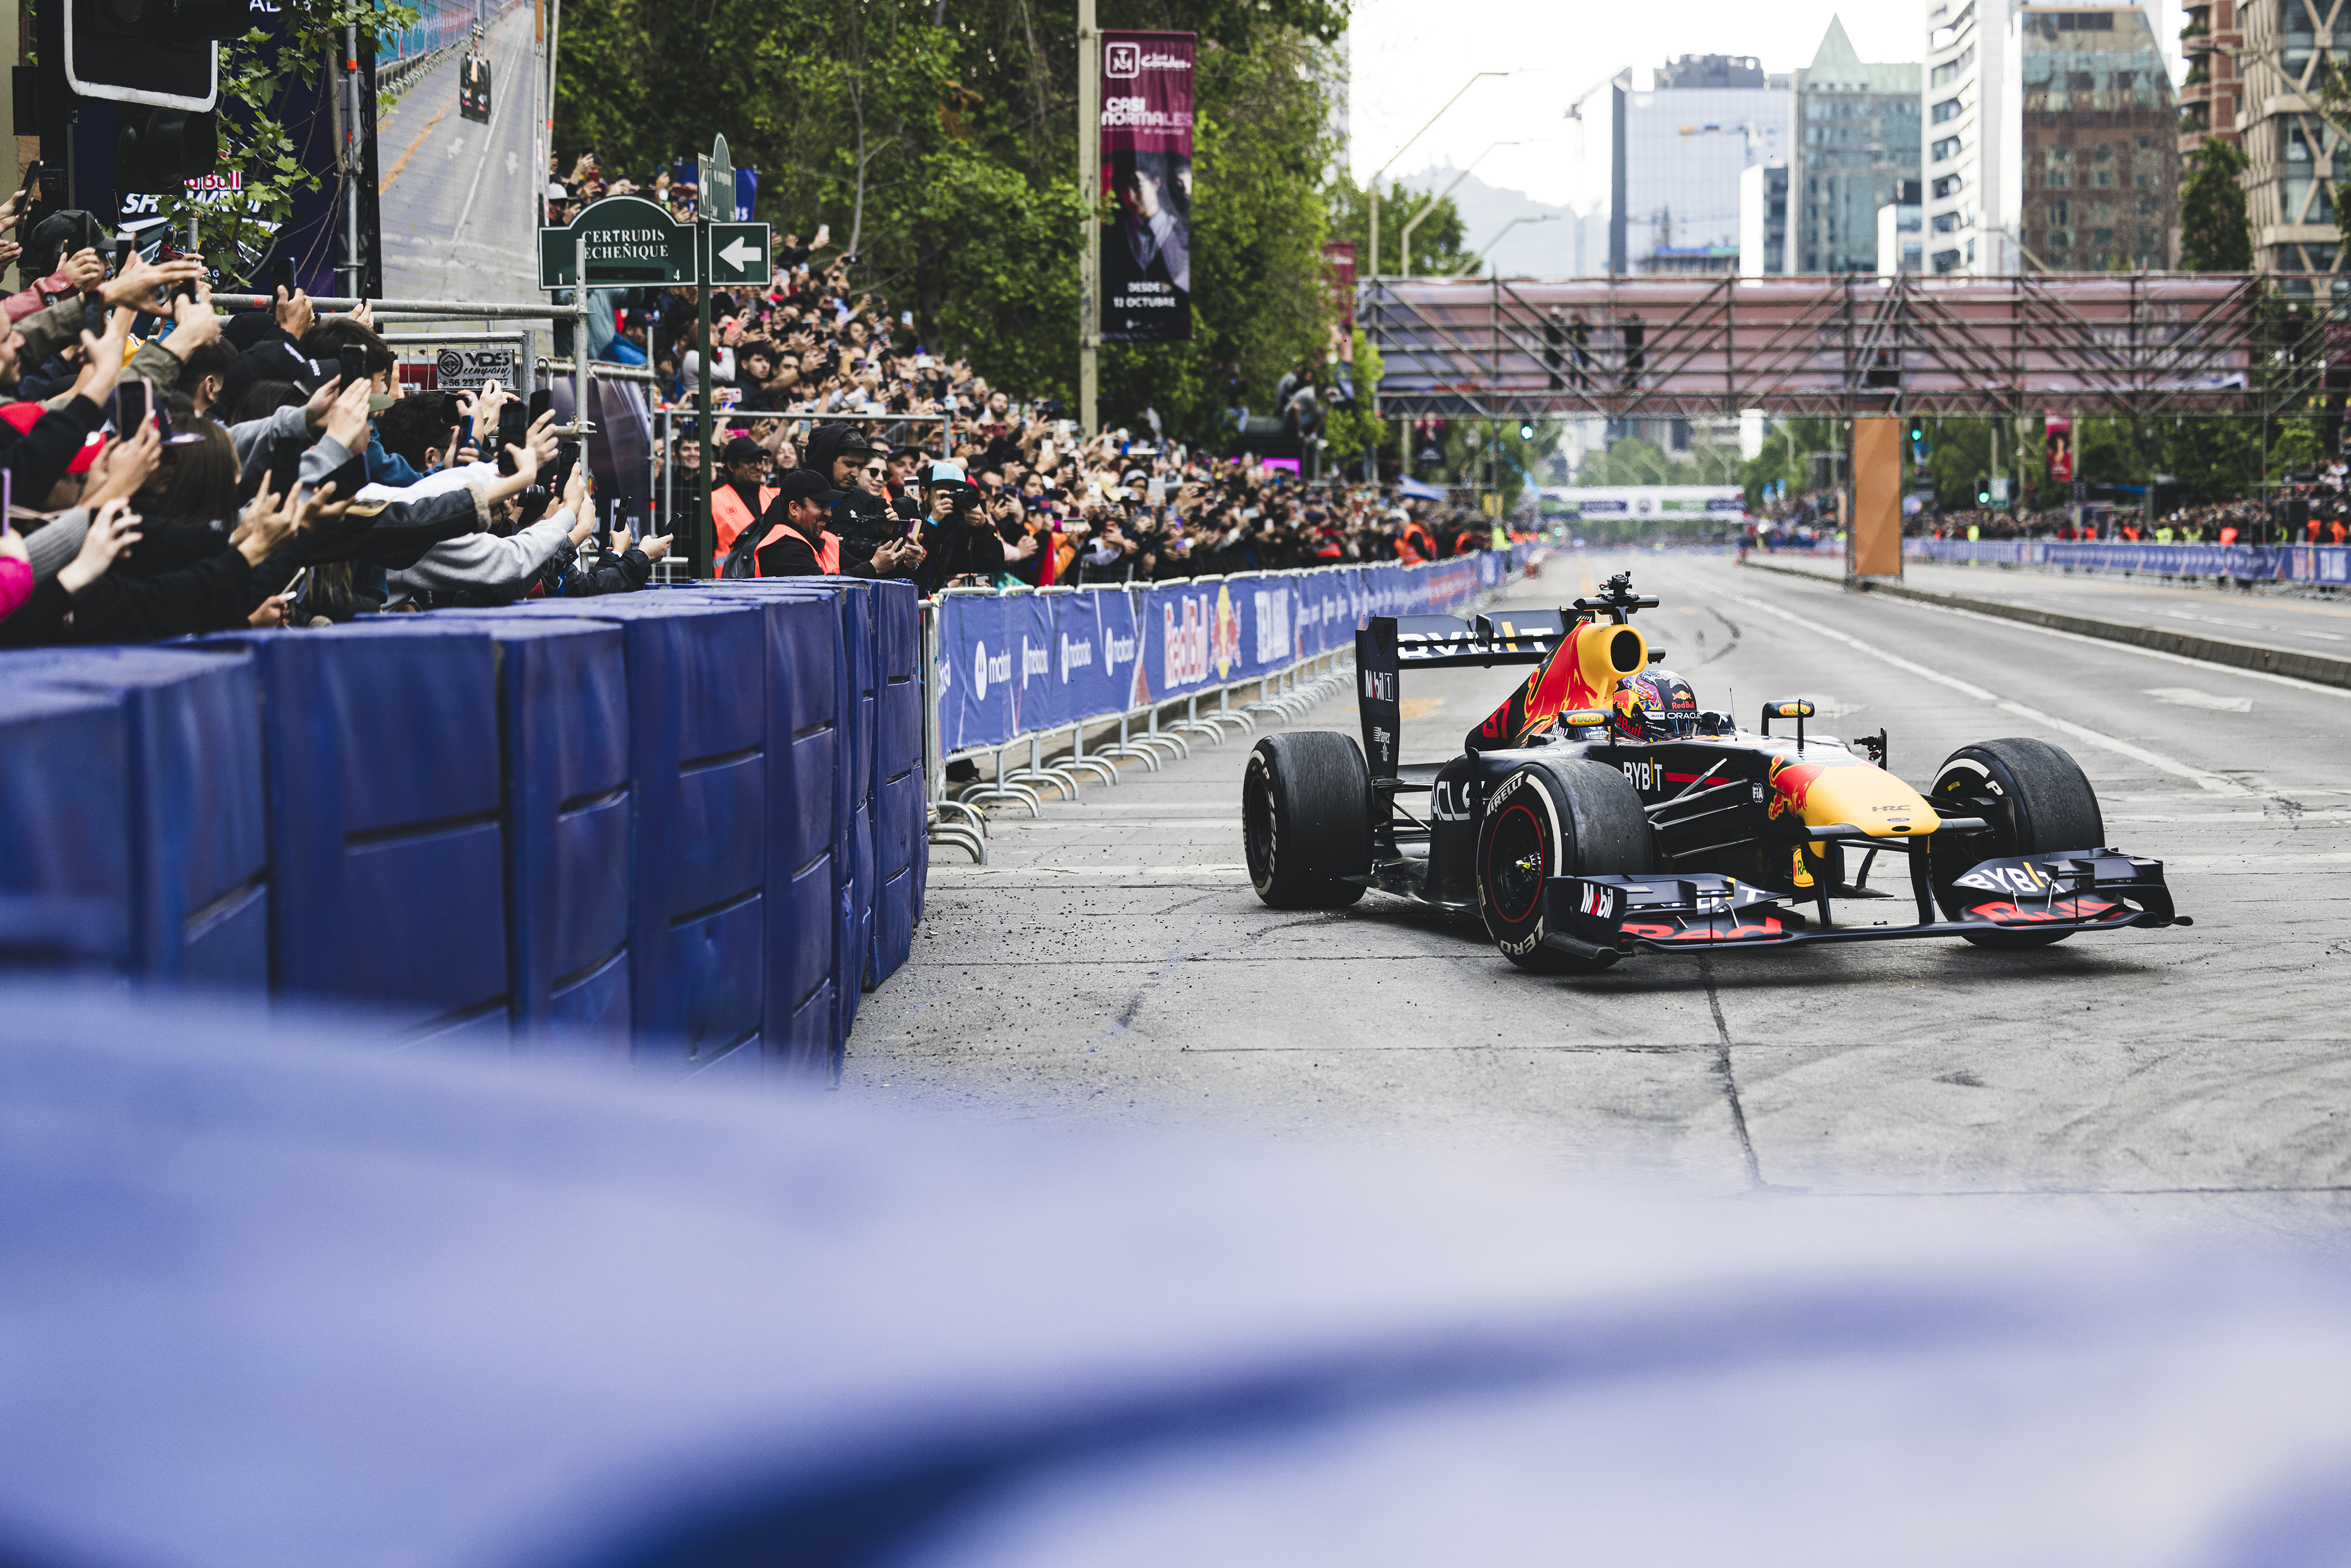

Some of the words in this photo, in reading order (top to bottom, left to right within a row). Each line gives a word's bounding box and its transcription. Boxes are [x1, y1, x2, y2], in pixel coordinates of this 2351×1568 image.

[674, 269, 680, 281] 4
[1365, 670, 1384, 700] Mobil
[1671, 701, 1685, 709] Red
[1685, 701, 1694, 709] Bull
[1581, 883, 1613, 919] Mobil
